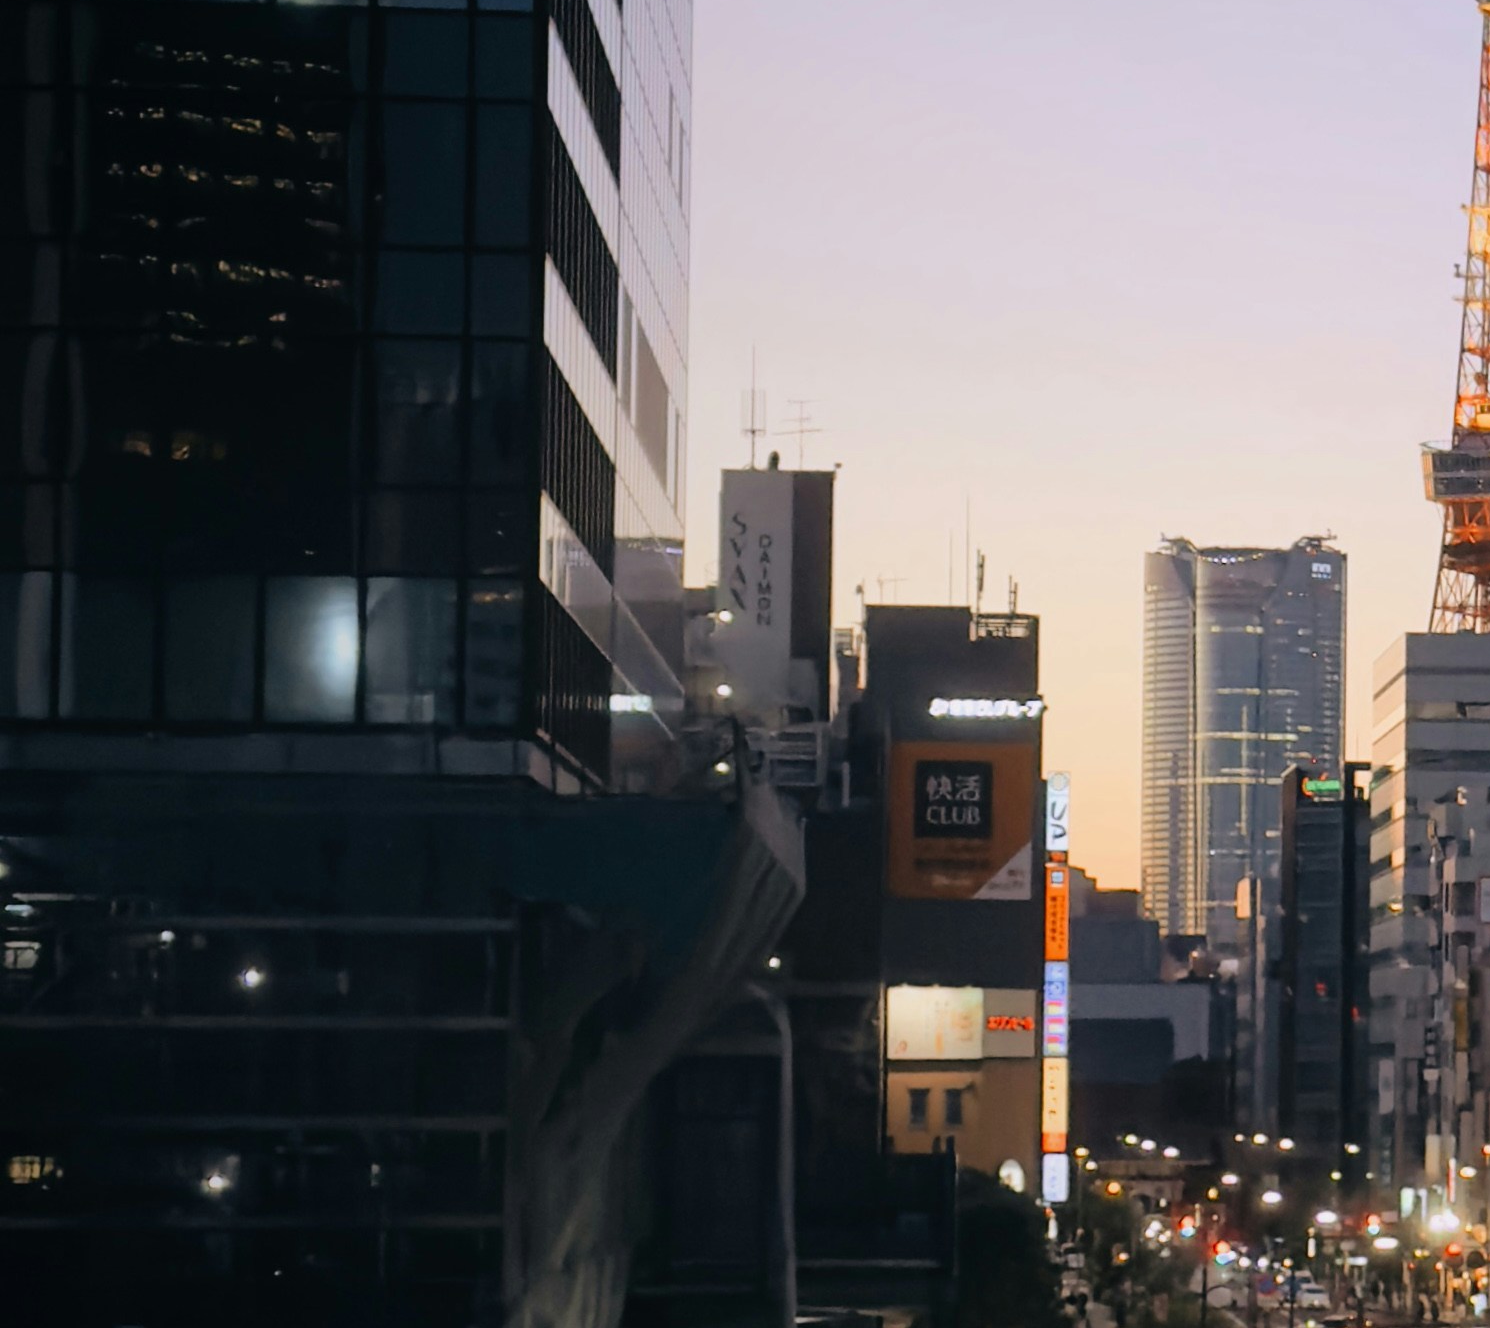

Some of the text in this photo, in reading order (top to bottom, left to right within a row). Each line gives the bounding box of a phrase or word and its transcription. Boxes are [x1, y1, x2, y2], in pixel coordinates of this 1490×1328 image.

[757, 533, 772, 626] DAIMON
[926, 774, 982, 802] 快活
[926, 806, 981, 825] CLUB
